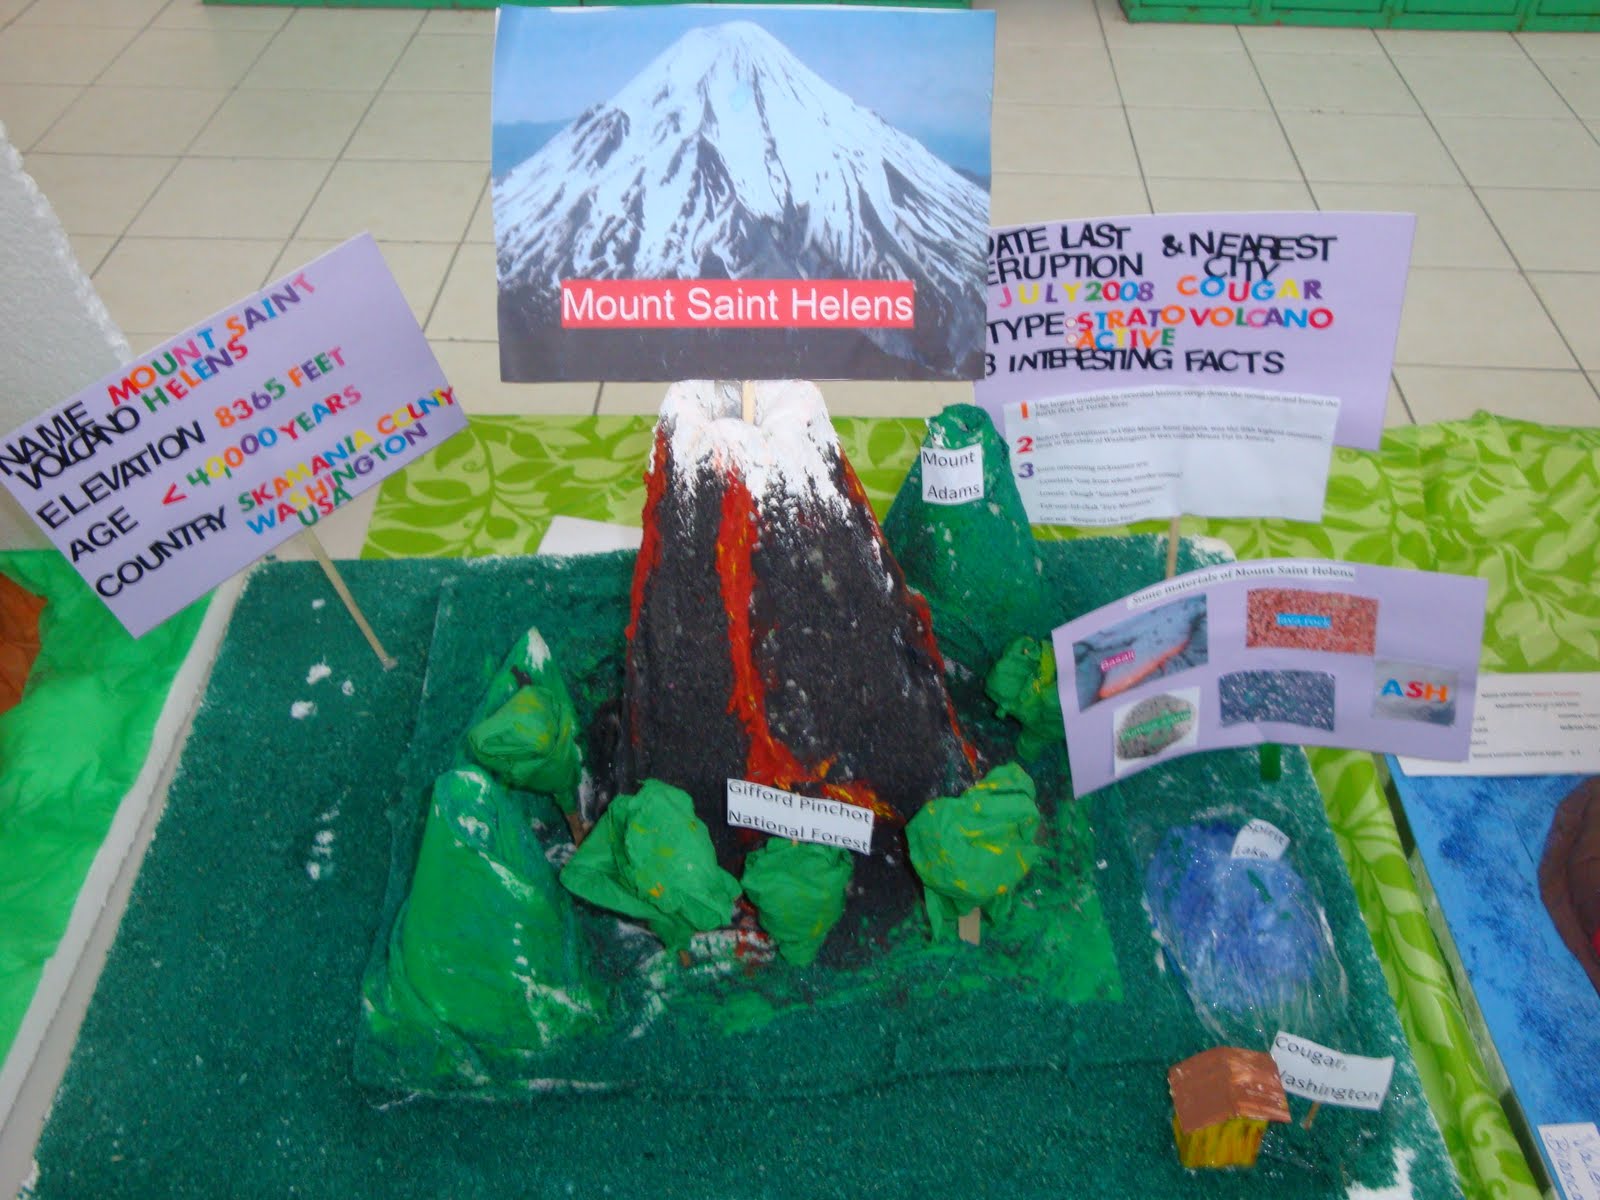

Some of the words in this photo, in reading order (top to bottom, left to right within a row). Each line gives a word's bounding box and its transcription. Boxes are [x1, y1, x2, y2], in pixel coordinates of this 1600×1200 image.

[1061, 223, 1131, 250] LAST
[1162, 234, 1184, 257] &
[1189, 230, 1338, 262] NEAREST
[1203, 255, 1280, 282] CITY
[563, 287, 675, 321] Mount
[687, 287, 779, 321] Saint
[791, 287, 914, 322] Helens
[1176, 275, 1323, 303] COUGAR
[1075, 328, 1176, 350] ACTIVE
[0, 401, 95, 476] NAME
[107, 327, 216, 407] MOUNT
[225, 272, 316, 340] SAINT
[141, 337, 249, 412] HELENS
[1008, 347, 1174, 373] INTERESTING
[1185, 349, 1286, 375] FACTS
[36, 420, 206, 530] ELEVATION
[214, 377, 287, 429] 8365
[288, 346, 345, 389] FEET
[1016, 436, 1034, 454] 2
[69, 505, 139, 562] AGE
[279, 384, 362, 442] YEARS
[922, 450, 975, 467] Mount
[1018, 462, 1035, 479] 3
[246, 422, 429, 535] WASHINGTON
[927, 484, 980, 500] Adams
[96, 505, 227, 598] COUNTRY
[238, 428, 374, 513] SKAMANIA
[297, 486, 353, 527] USA
[1132, 590, 1163, 604] Some
[1165, 573, 1218, 595] materials
[1220, 569, 1232, 580] of
[1235, 567, 1274, 578] Mount
[1277, 565, 1309, 576] Saint
[1312, 566, 1354, 579] Helens
[1381, 678, 1449, 705] ASH
[728, 778, 794, 808] Gifford
[799, 796, 871, 825] Pinchot
[727, 809, 805, 839] National
[811, 828, 869, 852] Forest
